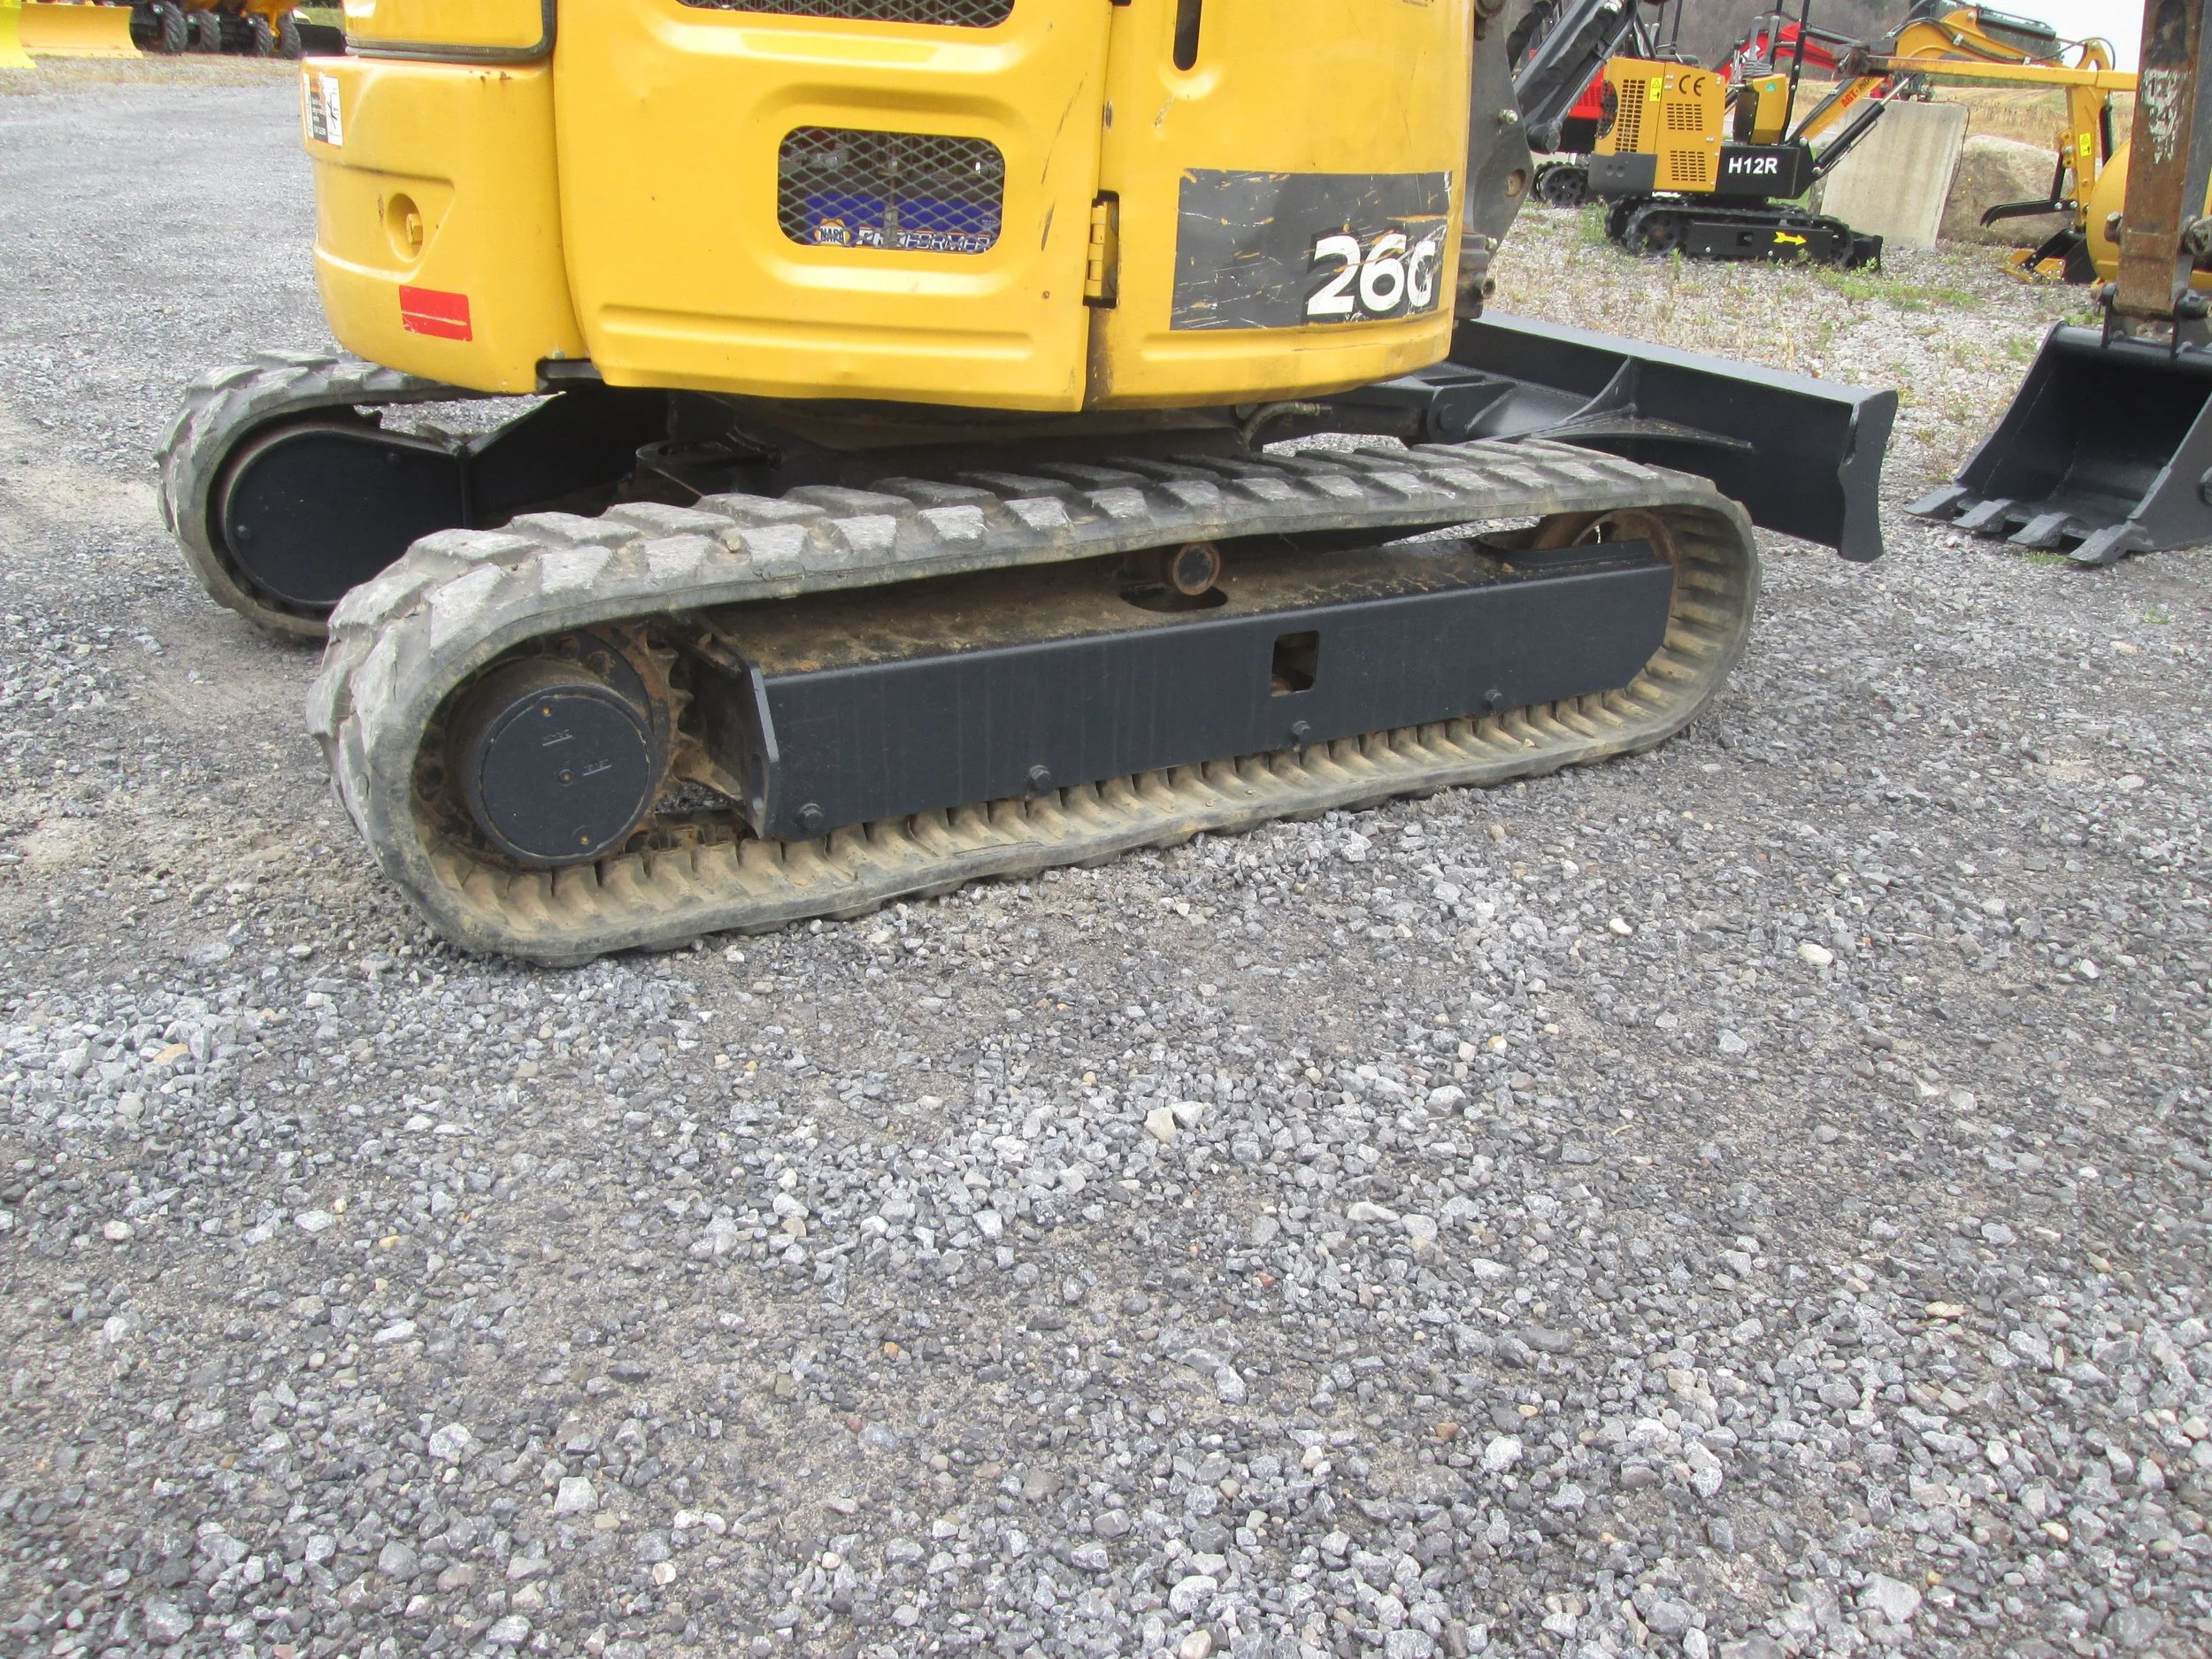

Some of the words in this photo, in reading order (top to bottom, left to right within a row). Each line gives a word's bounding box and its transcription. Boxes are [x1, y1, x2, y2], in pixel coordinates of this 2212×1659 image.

[1678, 74, 1706, 97] CE
[1728, 157, 1778, 174] H12R
[1307, 233, 1436, 316] 26G
